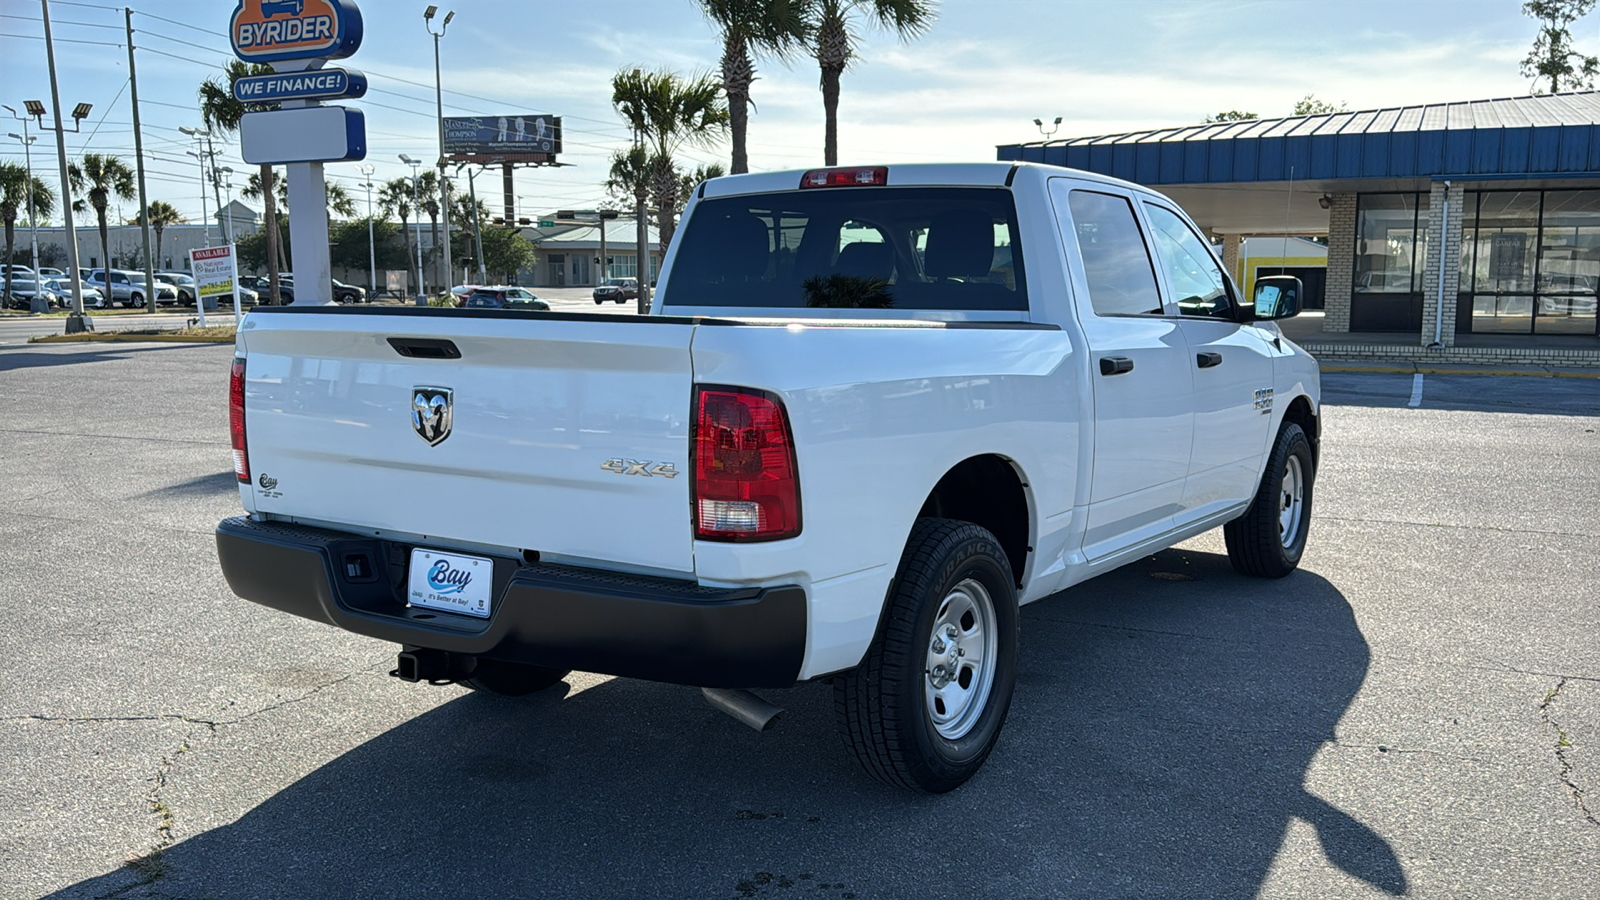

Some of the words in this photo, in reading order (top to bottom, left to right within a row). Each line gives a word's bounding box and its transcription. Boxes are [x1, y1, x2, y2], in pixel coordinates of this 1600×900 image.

[238, 17, 332, 46] BYRIDER
[240, 82, 264, 95] WE
[266, 75, 342, 93] FINANCE!
[444, 130, 477, 138] THOMPSON
[194, 248, 230, 259] AVAILABLE
[430, 559, 473, 593] Bay
[436, 594, 452, 602] Better
